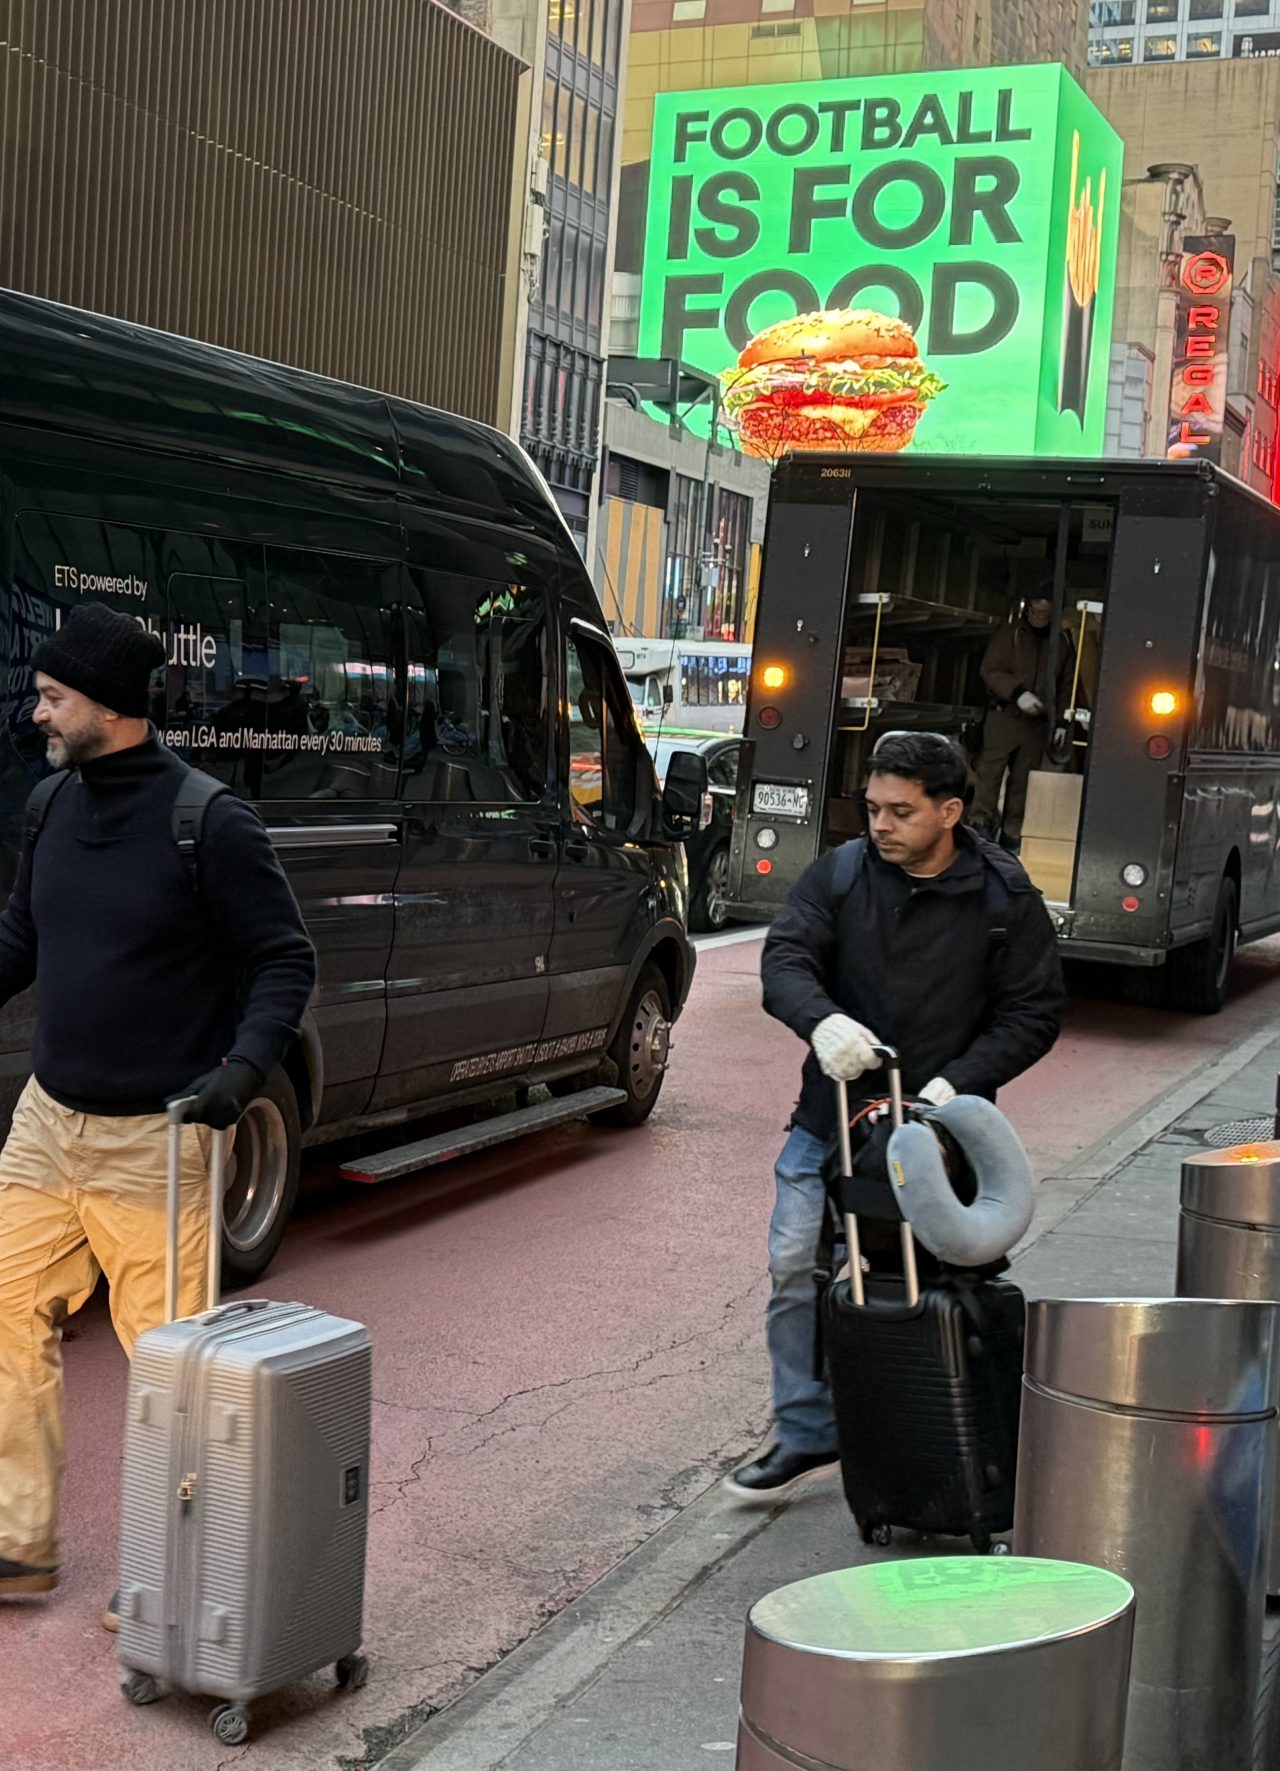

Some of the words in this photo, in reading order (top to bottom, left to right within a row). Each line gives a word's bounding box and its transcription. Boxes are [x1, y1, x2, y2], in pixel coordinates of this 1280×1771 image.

[673, 88, 1032, 163] FOOTBALL
[666, 170, 761, 260] IS
[788, 155, 1024, 254] FOR
[660, 261, 1020, 359] FOOD
[1180, 305, 1219, 444] REGAL
[54, 565, 78, 588] ETS
[80, 573, 131, 594] powered
[133, 574, 147, 602] by
[139, 616, 217, 668] uttle
[192, 725, 217, 747] LGA
[219, 727, 242, 748] and
[243, 727, 298, 750] Manhattan
[300, 734, 329, 756] every
[329, 731, 344, 751] 30
[344, 732, 382, 752] minutes
